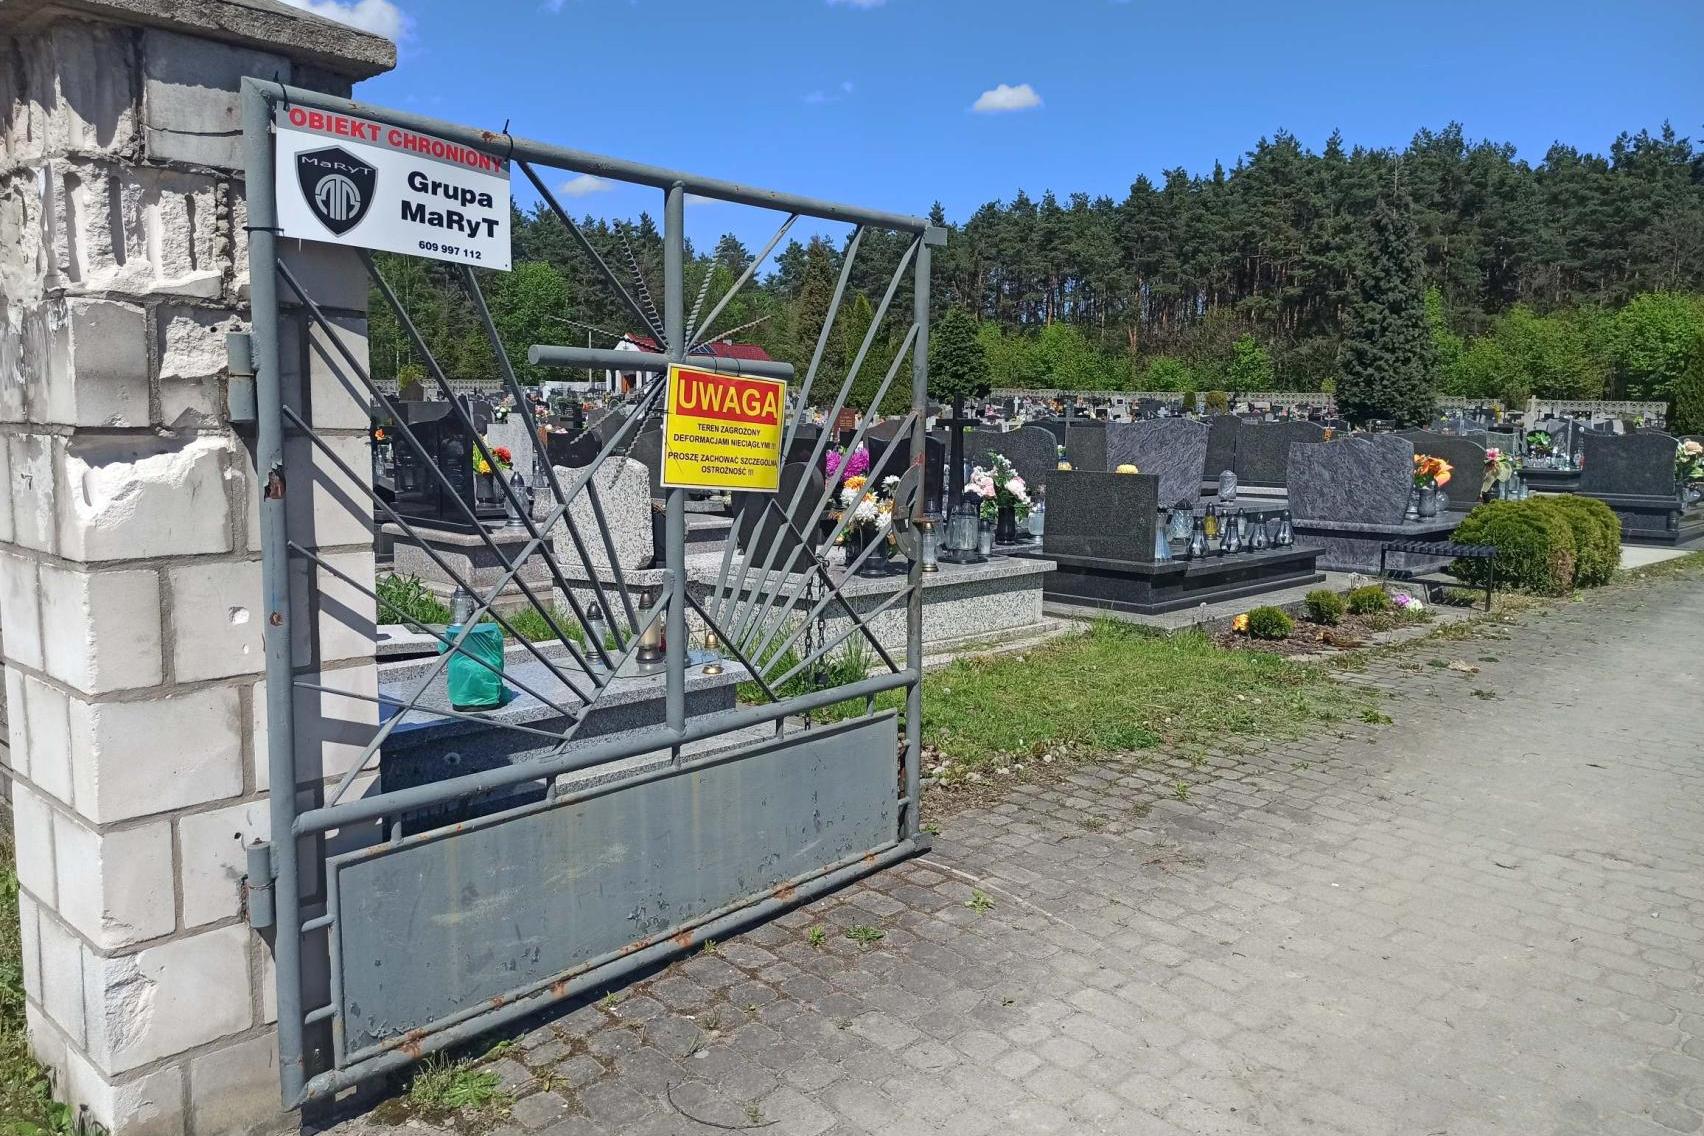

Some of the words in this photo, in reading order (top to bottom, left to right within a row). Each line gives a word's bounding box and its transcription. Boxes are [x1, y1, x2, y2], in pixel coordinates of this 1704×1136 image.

[288, 107, 381, 142] OBIEKT
[388, 129, 502, 173] CHRONIONY
[407, 171, 493, 209] Grupa
[401, 200, 499, 239] MaRyT
[418, 240, 439, 252] 609
[441, 243, 460, 256] 997
[463, 249, 482, 260] 112
[679, 379, 778, 419] UWAGA
[673, 433, 730, 446] DEFORMACJAMI
[698, 423, 718, 433] TEREN
[668, 451, 699, 463] PROSZĘ
[700, 453, 739, 465] ZACHOWAĆ
